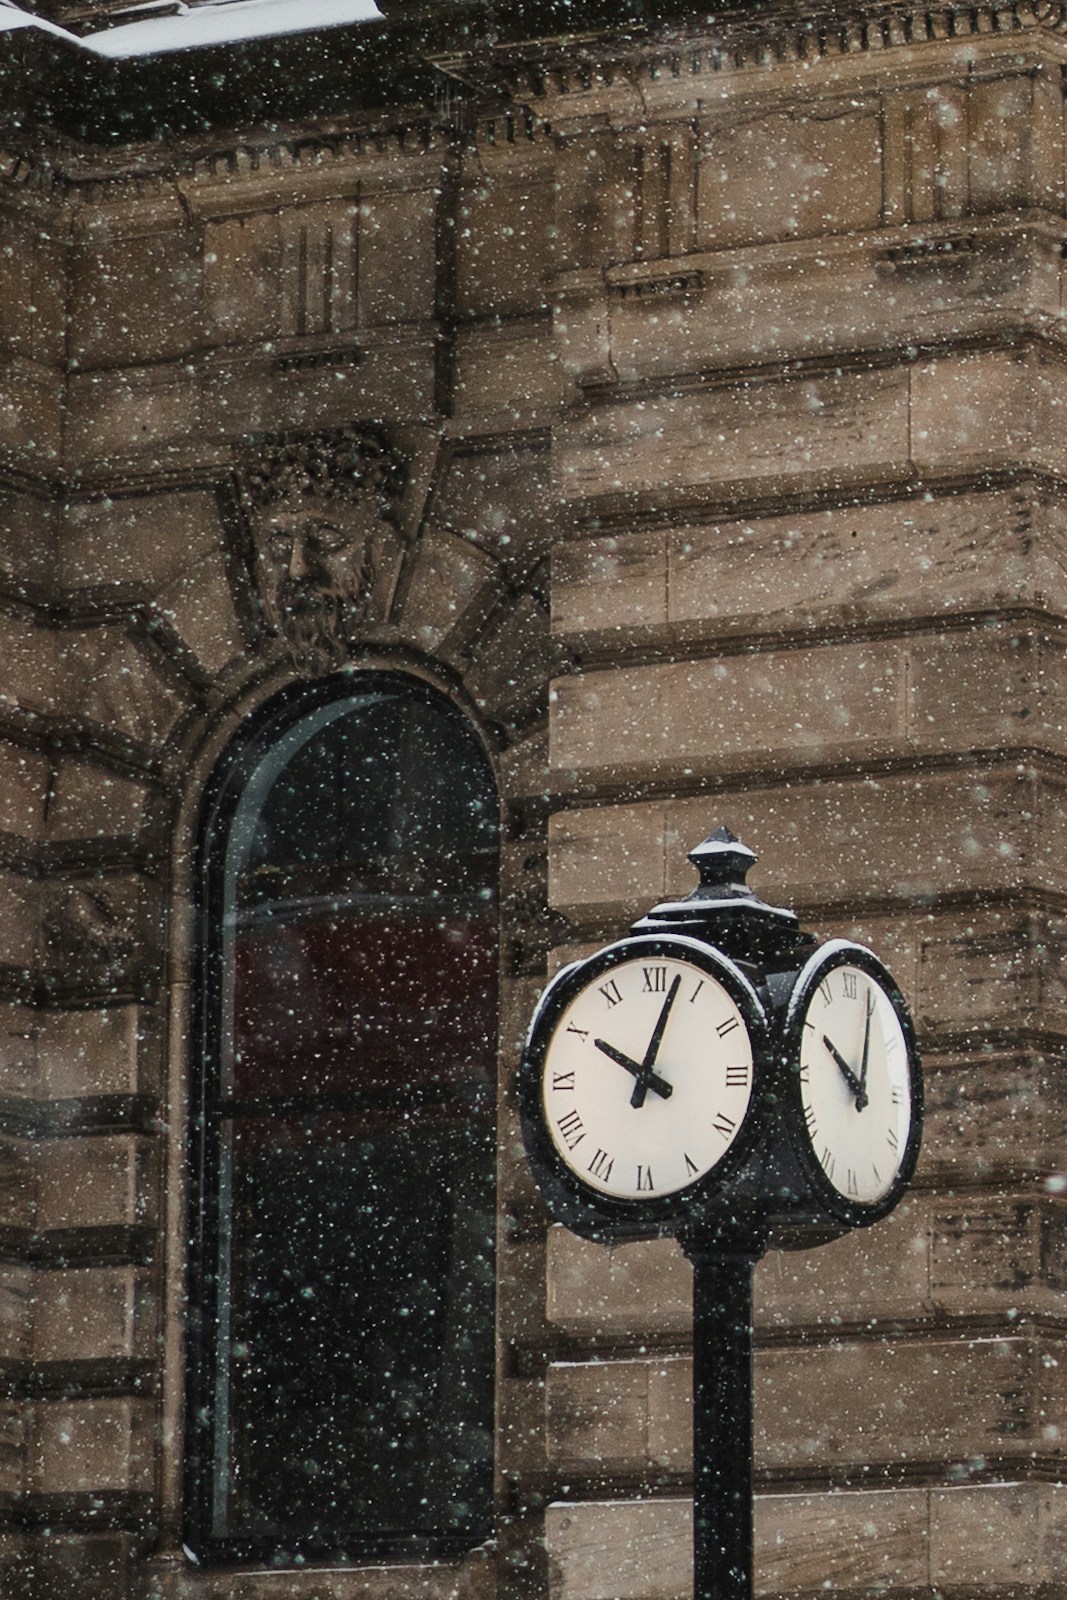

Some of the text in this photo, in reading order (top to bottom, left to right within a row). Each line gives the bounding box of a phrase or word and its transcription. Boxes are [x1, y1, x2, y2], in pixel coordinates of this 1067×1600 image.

[642, 967, 668, 992] XII
[689, 980, 705, 1003] I
[842, 972, 857, 999] XII
[598, 979, 623, 1009] XI
[566, 1021, 589, 1042] X
[716, 1016, 740, 1039] II
[553, 1071, 575, 1091] IX
[726, 1066, 749, 1087] III
[557, 1109, 587, 1151] VIII
[712, 1112, 737, 1141] IV
[587, 1148, 615, 1182] VII
[684, 1152, 699, 1177] V
[636, 1165, 655, 1191] VI
